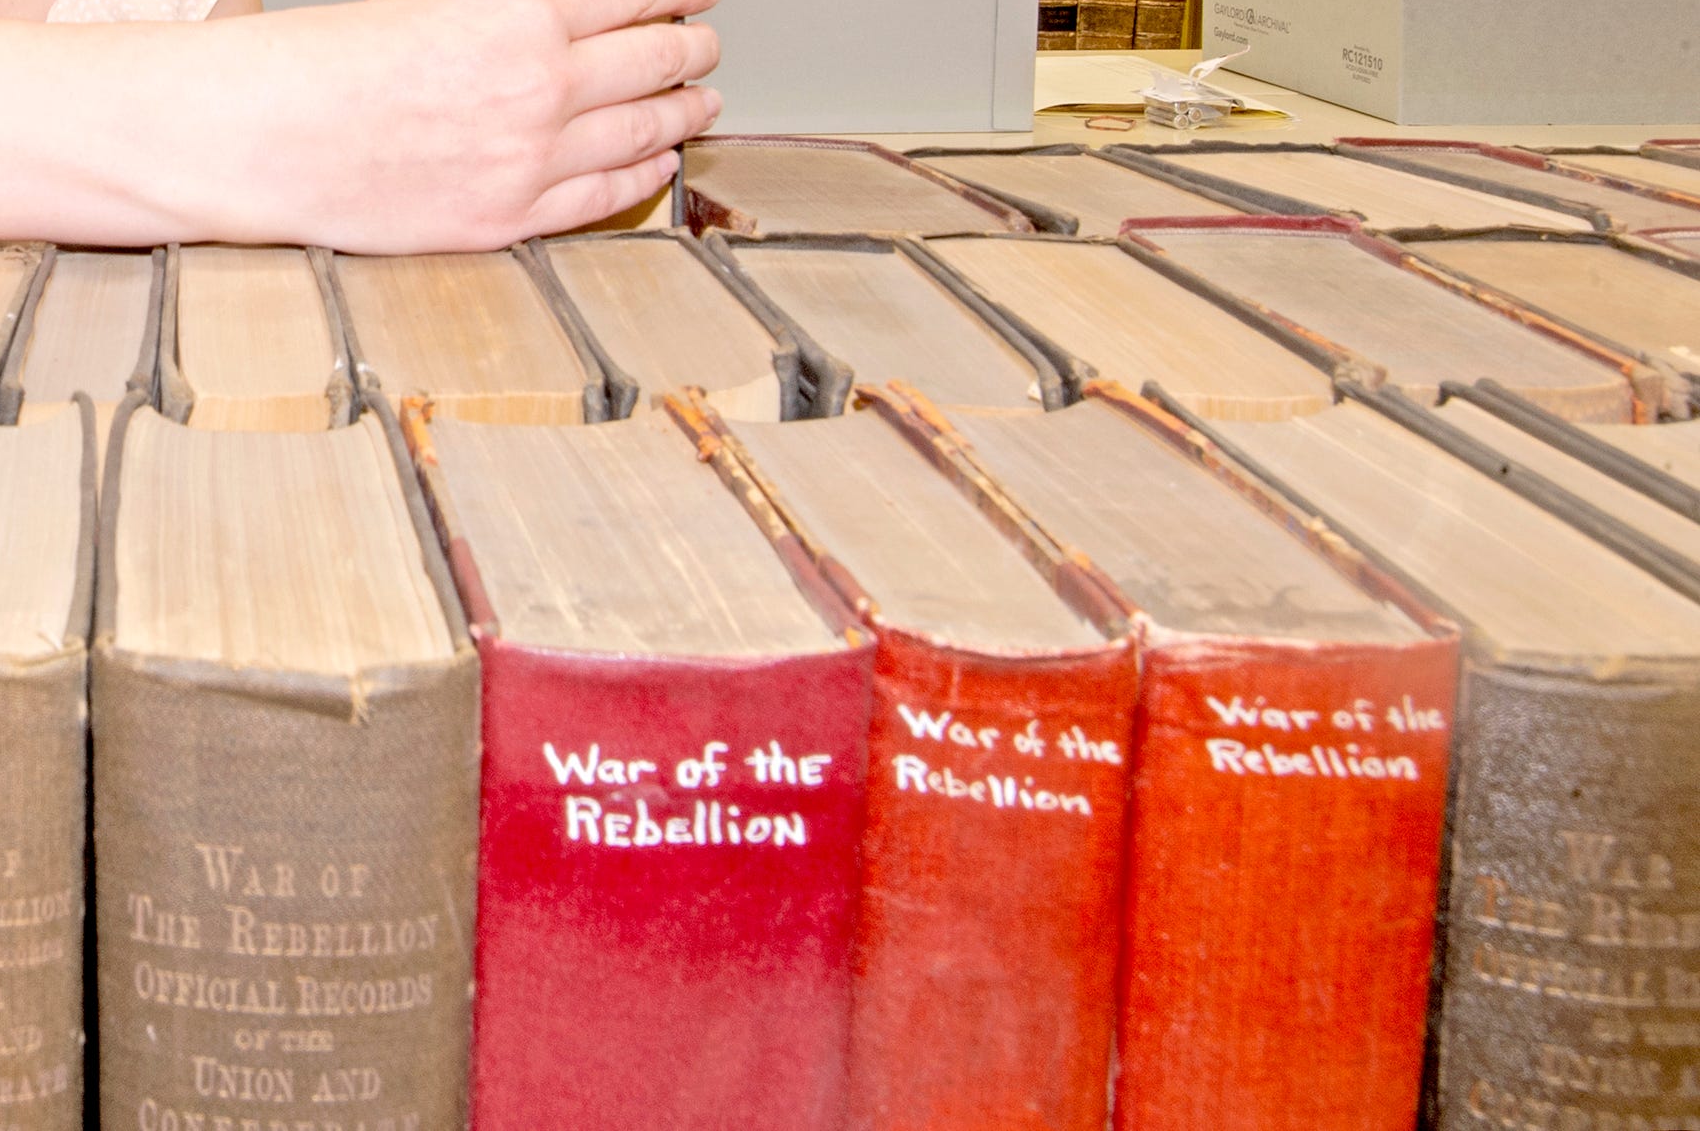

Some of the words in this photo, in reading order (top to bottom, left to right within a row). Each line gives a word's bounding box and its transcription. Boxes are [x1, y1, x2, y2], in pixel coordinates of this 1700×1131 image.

[1214, 3, 1245, 21] GAYLORD
[1214, 27, 1248, 45] Gaylord.com
[1342, 48, 1383, 71] RC121510
[897, 704, 999, 749] War
[1014, 719, 1046, 758] of
[1058, 725, 1123, 765] the
[1206, 695, 1319, 731] War
[1332, 698, 1374, 731] of
[1387, 694, 1446, 732] the
[543, 742, 657, 786] War
[676, 741, 729, 789] of
[1206, 738, 1420, 781] Rebellion
[892, 754, 1092, 816] Rebellion
[195, 842, 296, 898] WAR
[320, 862, 371, 899] OF
[128, 894, 201, 950] THE
[224, 903, 439, 957] REBELLION
[134, 960, 287, 1015] OFFICIAL
[294, 973, 433, 1016] RECORDS
[234, 1028, 271, 1051] OF
[278, 1029, 335, 1052] THE
[193, 1055, 295, 1104] UNION
[311, 1067, 382, 1104] AND
